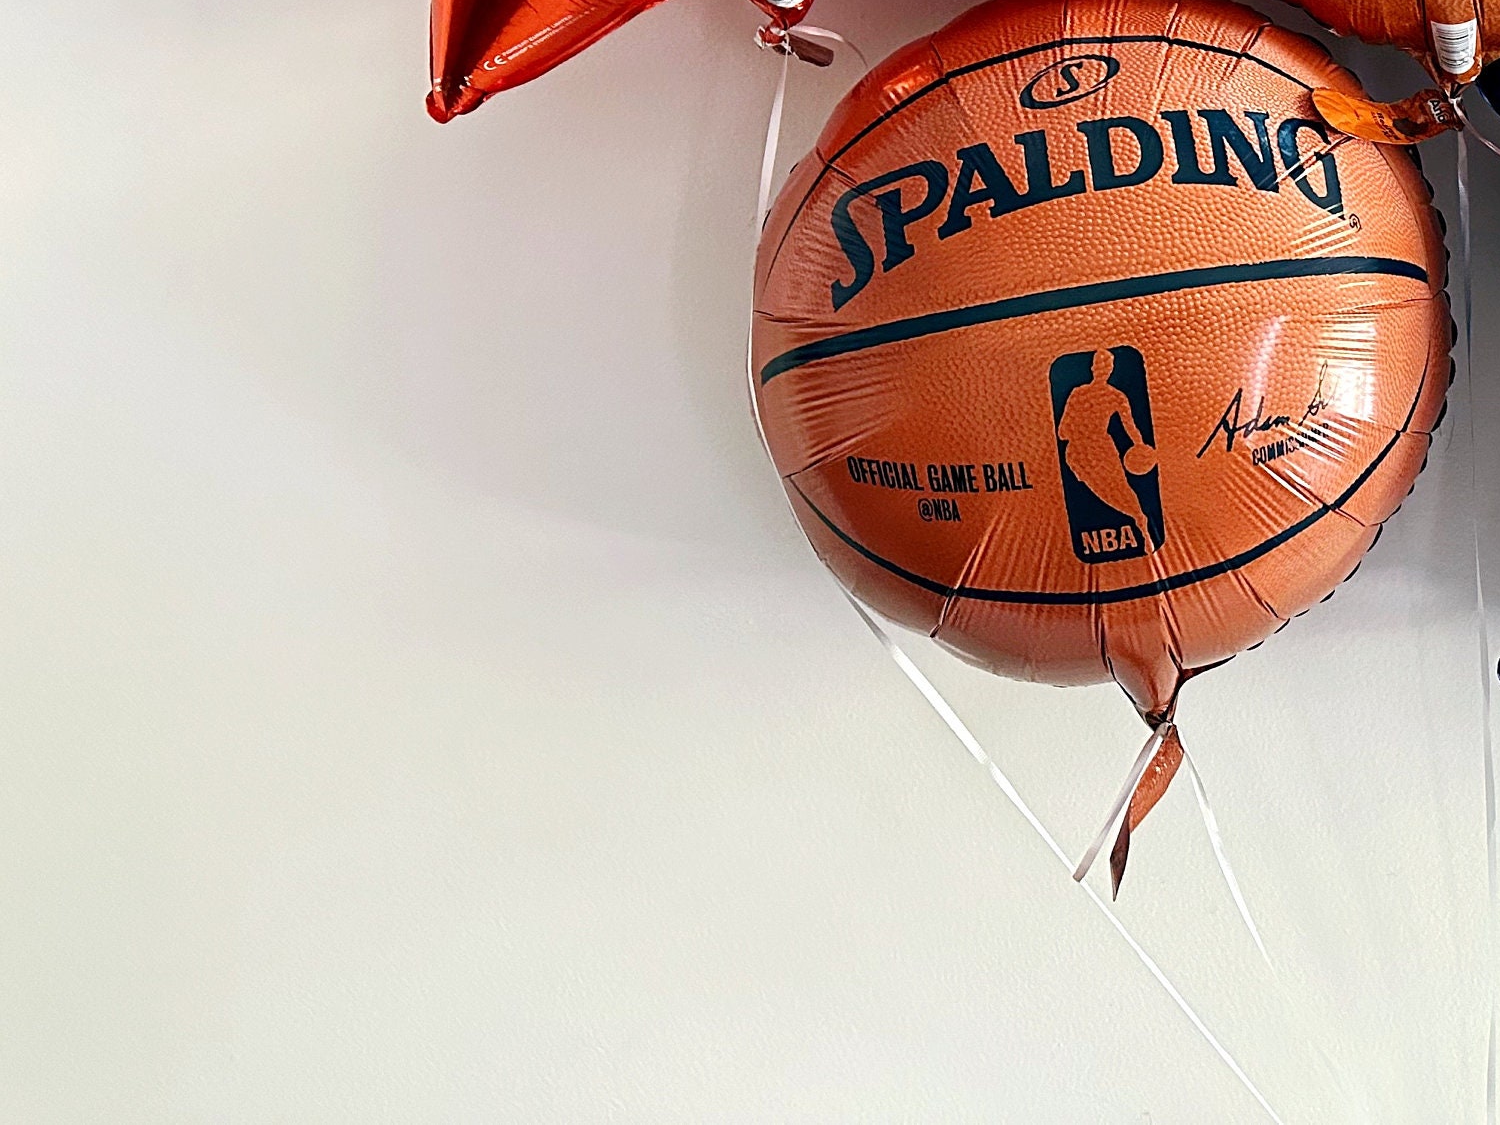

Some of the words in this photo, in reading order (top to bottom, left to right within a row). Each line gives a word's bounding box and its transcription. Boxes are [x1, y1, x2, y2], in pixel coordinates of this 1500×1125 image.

[829, 107, 1347, 314] SPALDING
[846, 455, 925, 492] OFFICIAL
[927, 463, 980, 493] GAME
[982, 461, 1034, 493] BALL
[917, 497, 962, 523] @NBA
[1081, 525, 1138, 555] NBA
